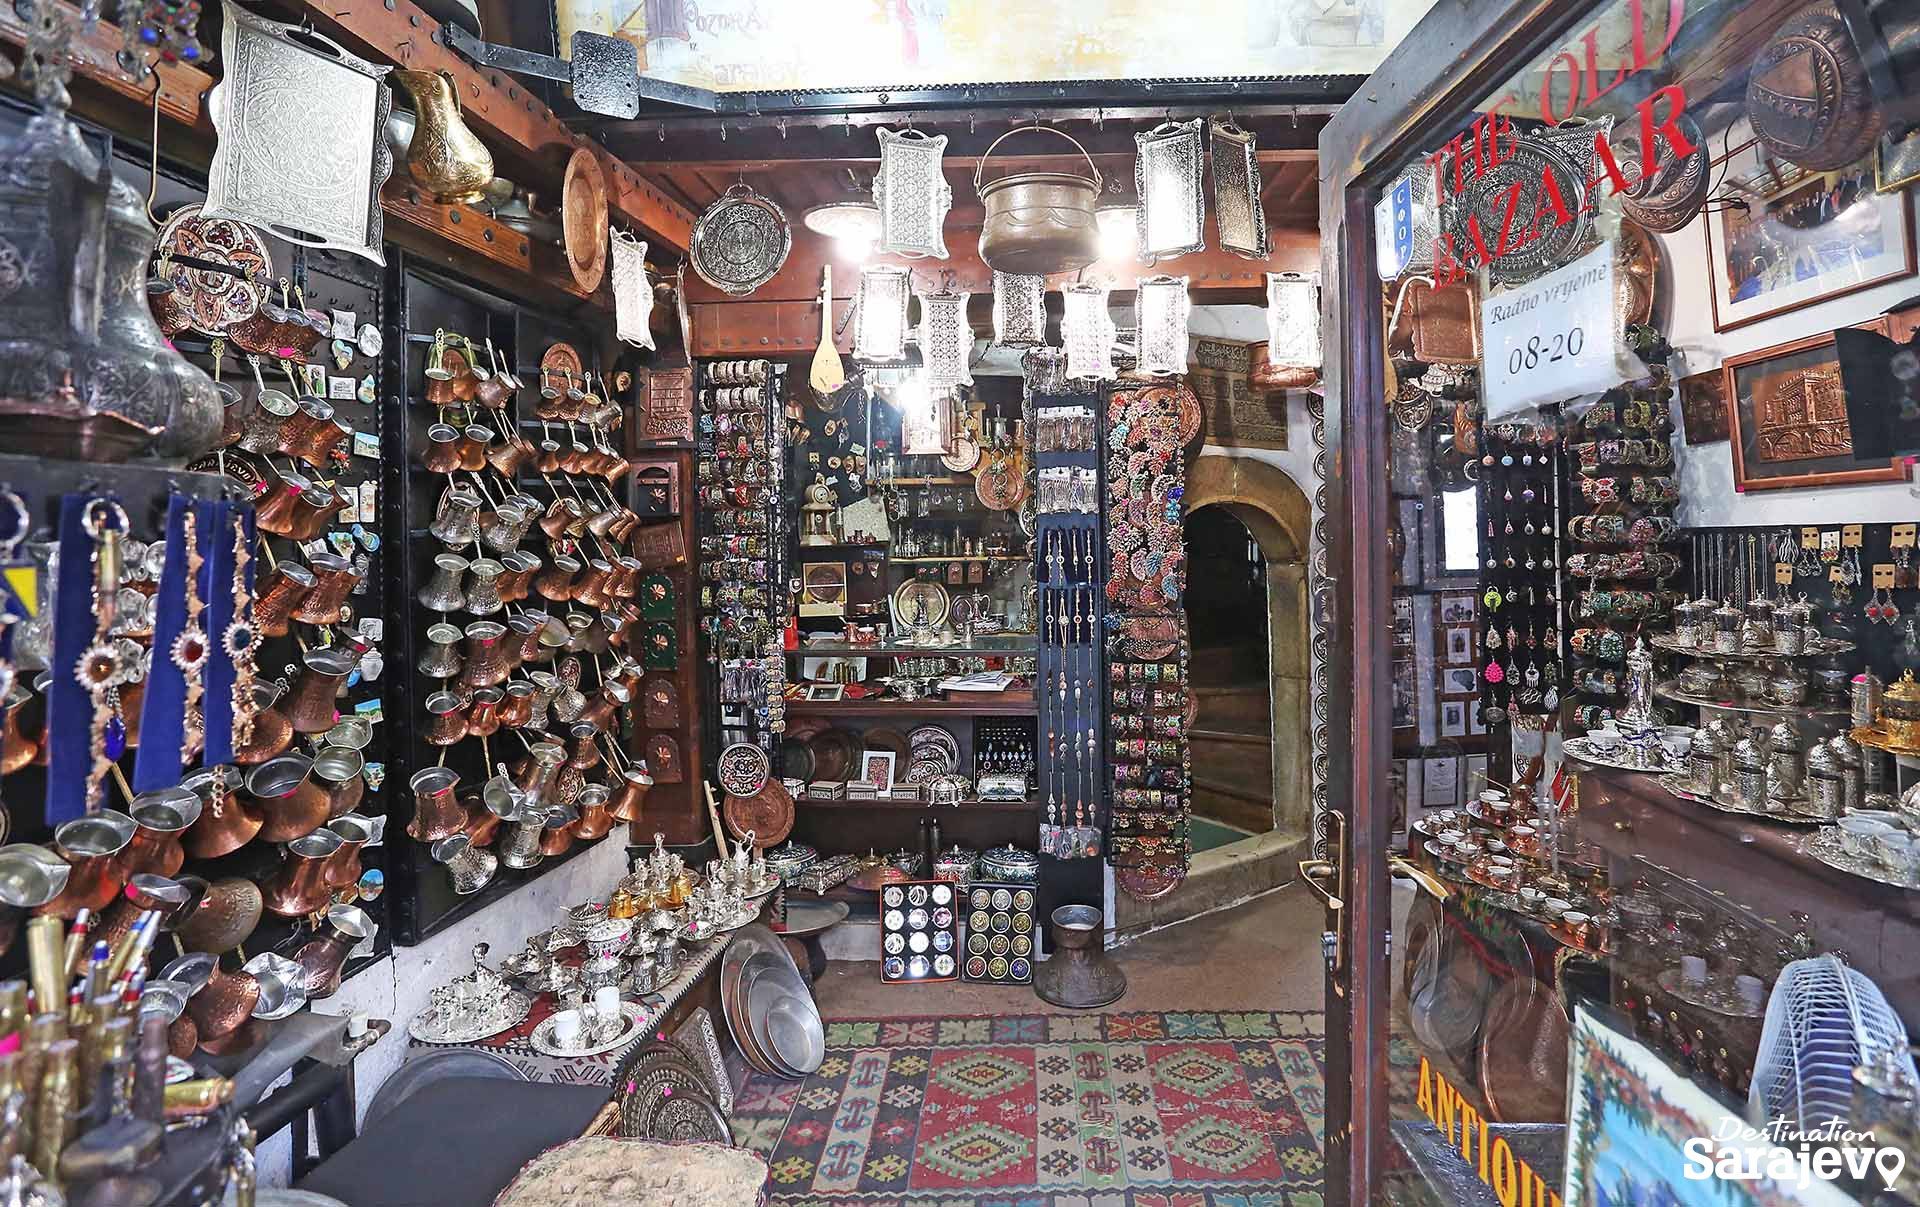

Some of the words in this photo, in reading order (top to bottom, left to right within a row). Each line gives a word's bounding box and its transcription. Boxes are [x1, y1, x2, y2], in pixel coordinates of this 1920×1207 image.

[1425, 96, 1517, 207] THE
[1540, 0, 1684, 126] OLD
[1397, 188, 1408, 260] COOP
[1431, 85, 1699, 295] BAZAAR
[1490, 292, 1539, 325] Radno
[1543, 263, 1608, 304] vrijeme
[1509, 327, 1584, 375] 08-20
[1416, 1055, 1563, 1207] ANTIQU
